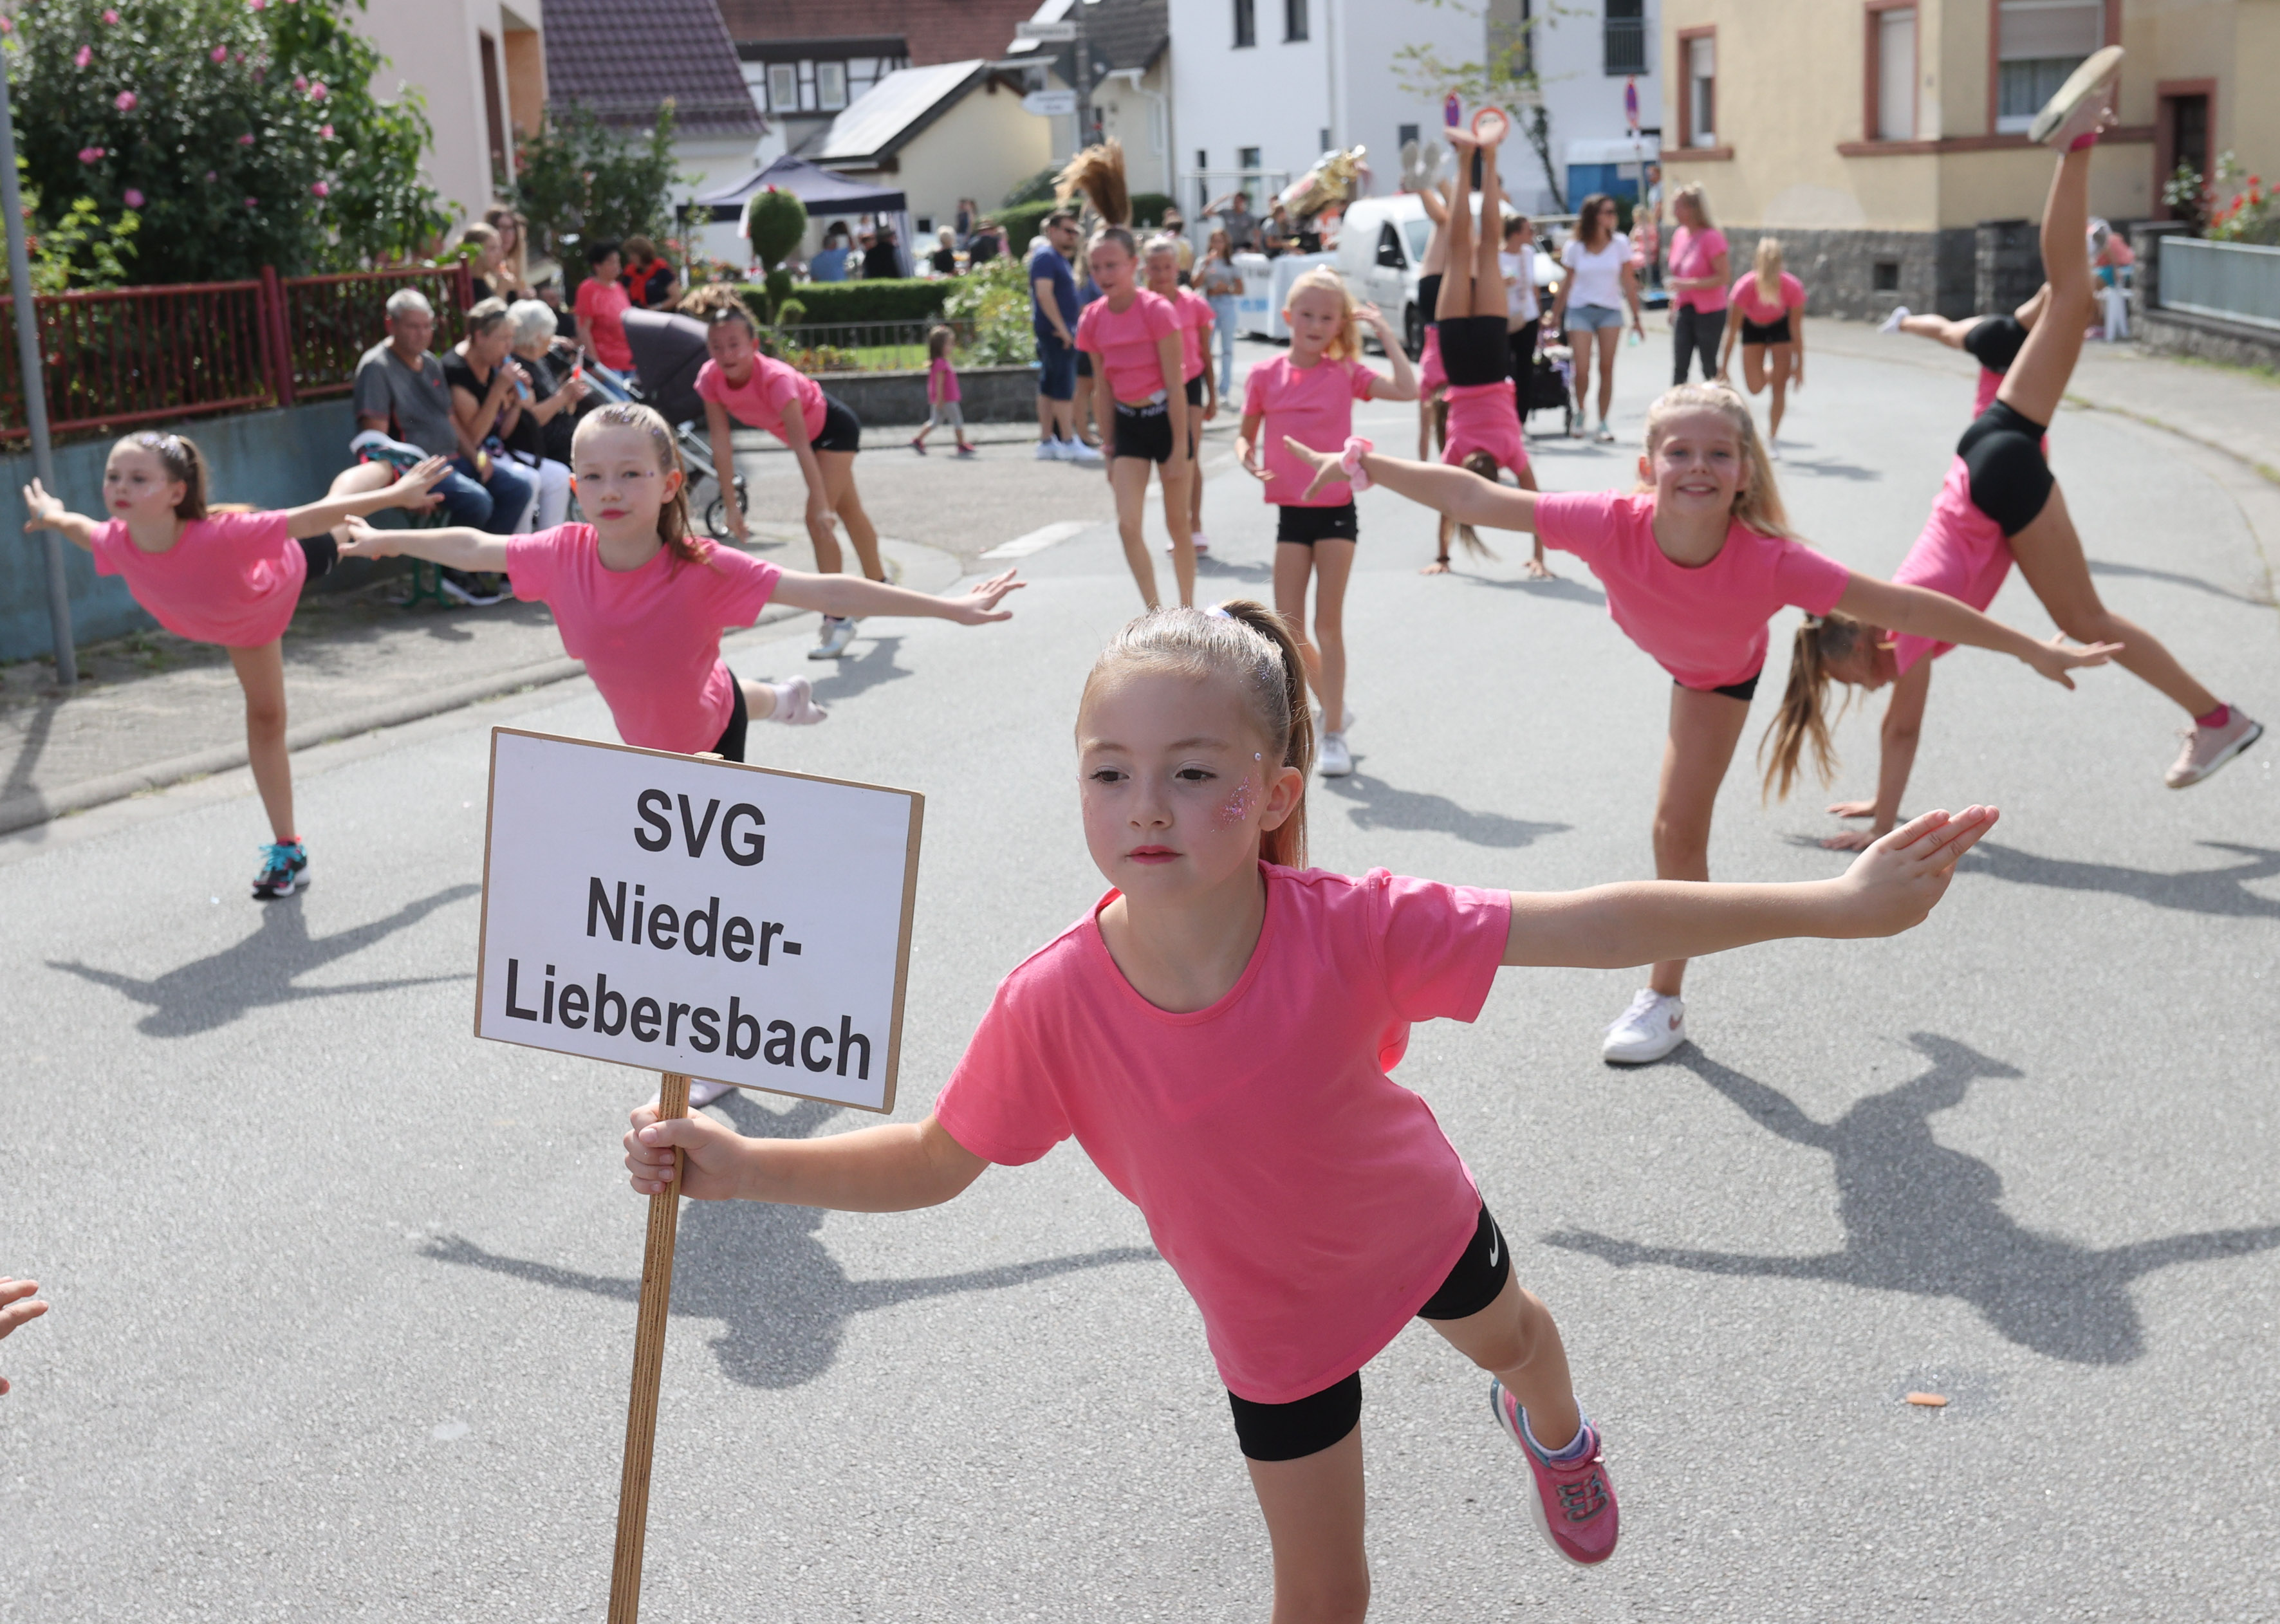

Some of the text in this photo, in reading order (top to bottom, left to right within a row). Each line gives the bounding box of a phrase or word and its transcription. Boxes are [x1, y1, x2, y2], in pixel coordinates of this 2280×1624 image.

[634, 788, 766, 867] SVG
[586, 876, 802, 966] Nieder-
[505, 958, 871, 1080] Liebersbach
